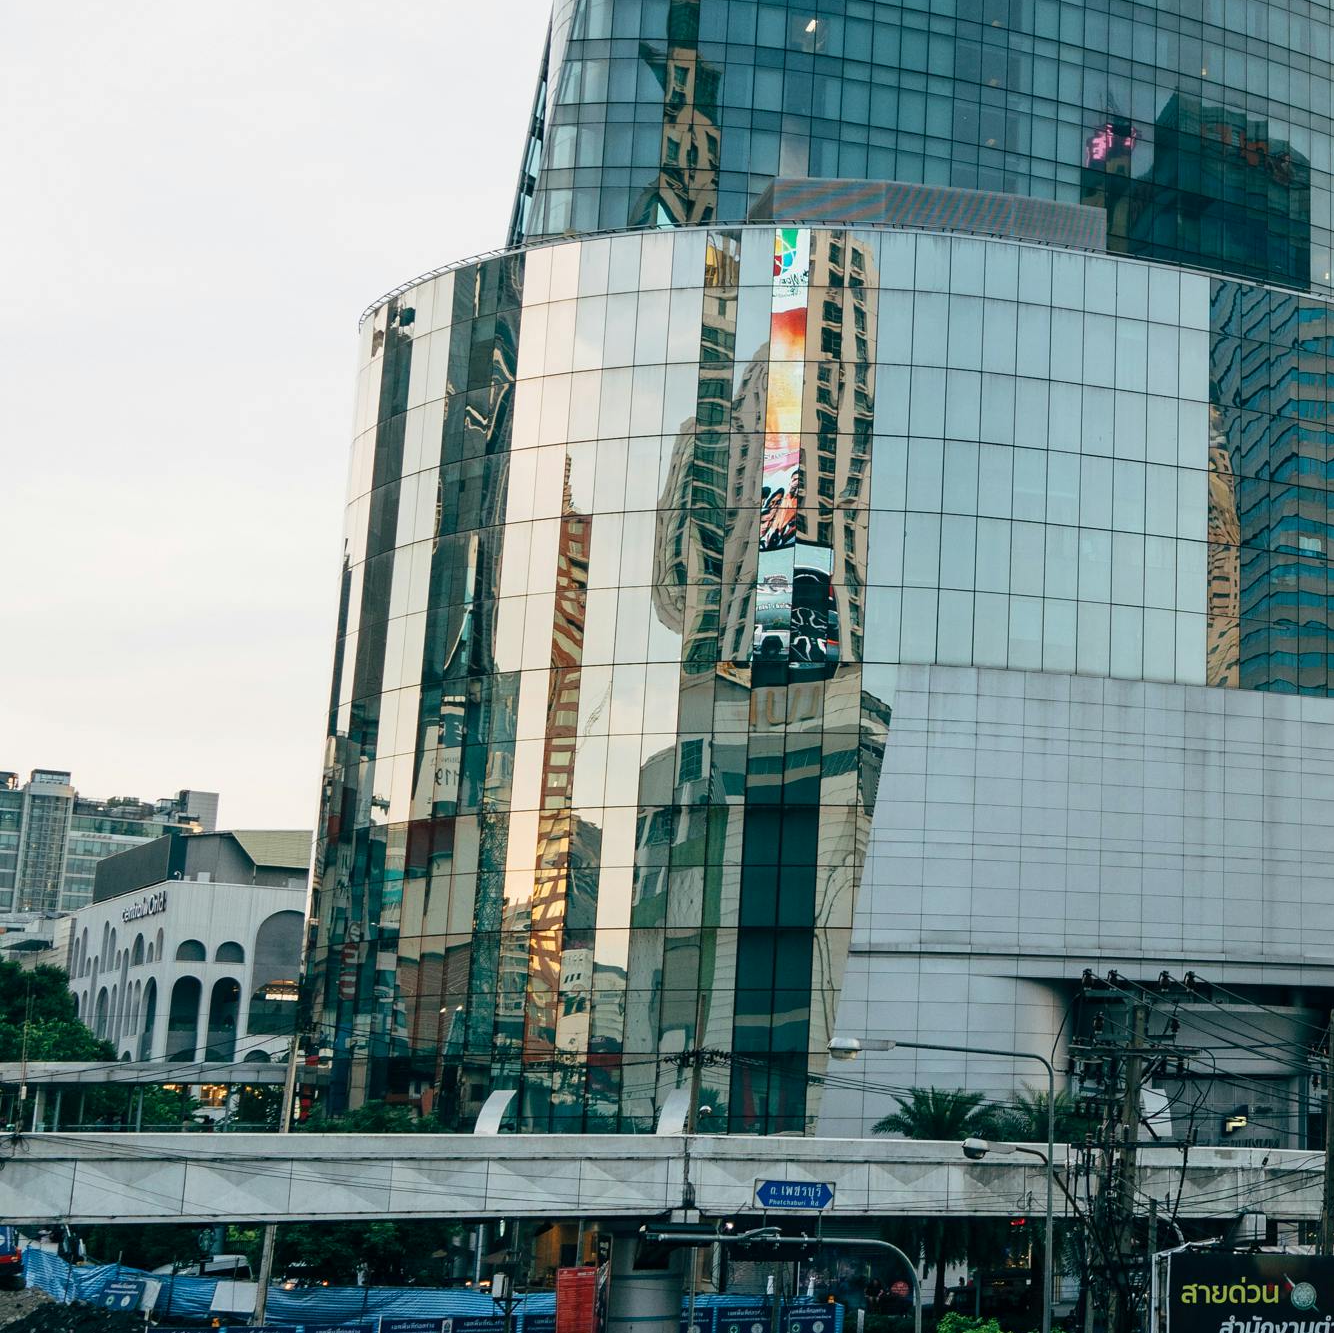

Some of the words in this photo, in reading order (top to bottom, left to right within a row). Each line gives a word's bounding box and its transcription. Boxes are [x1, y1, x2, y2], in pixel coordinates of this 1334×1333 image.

[781, 1184, 822, 1201] เพชรบุรี
[1181, 1276, 1279, 1304] สายด่วน
